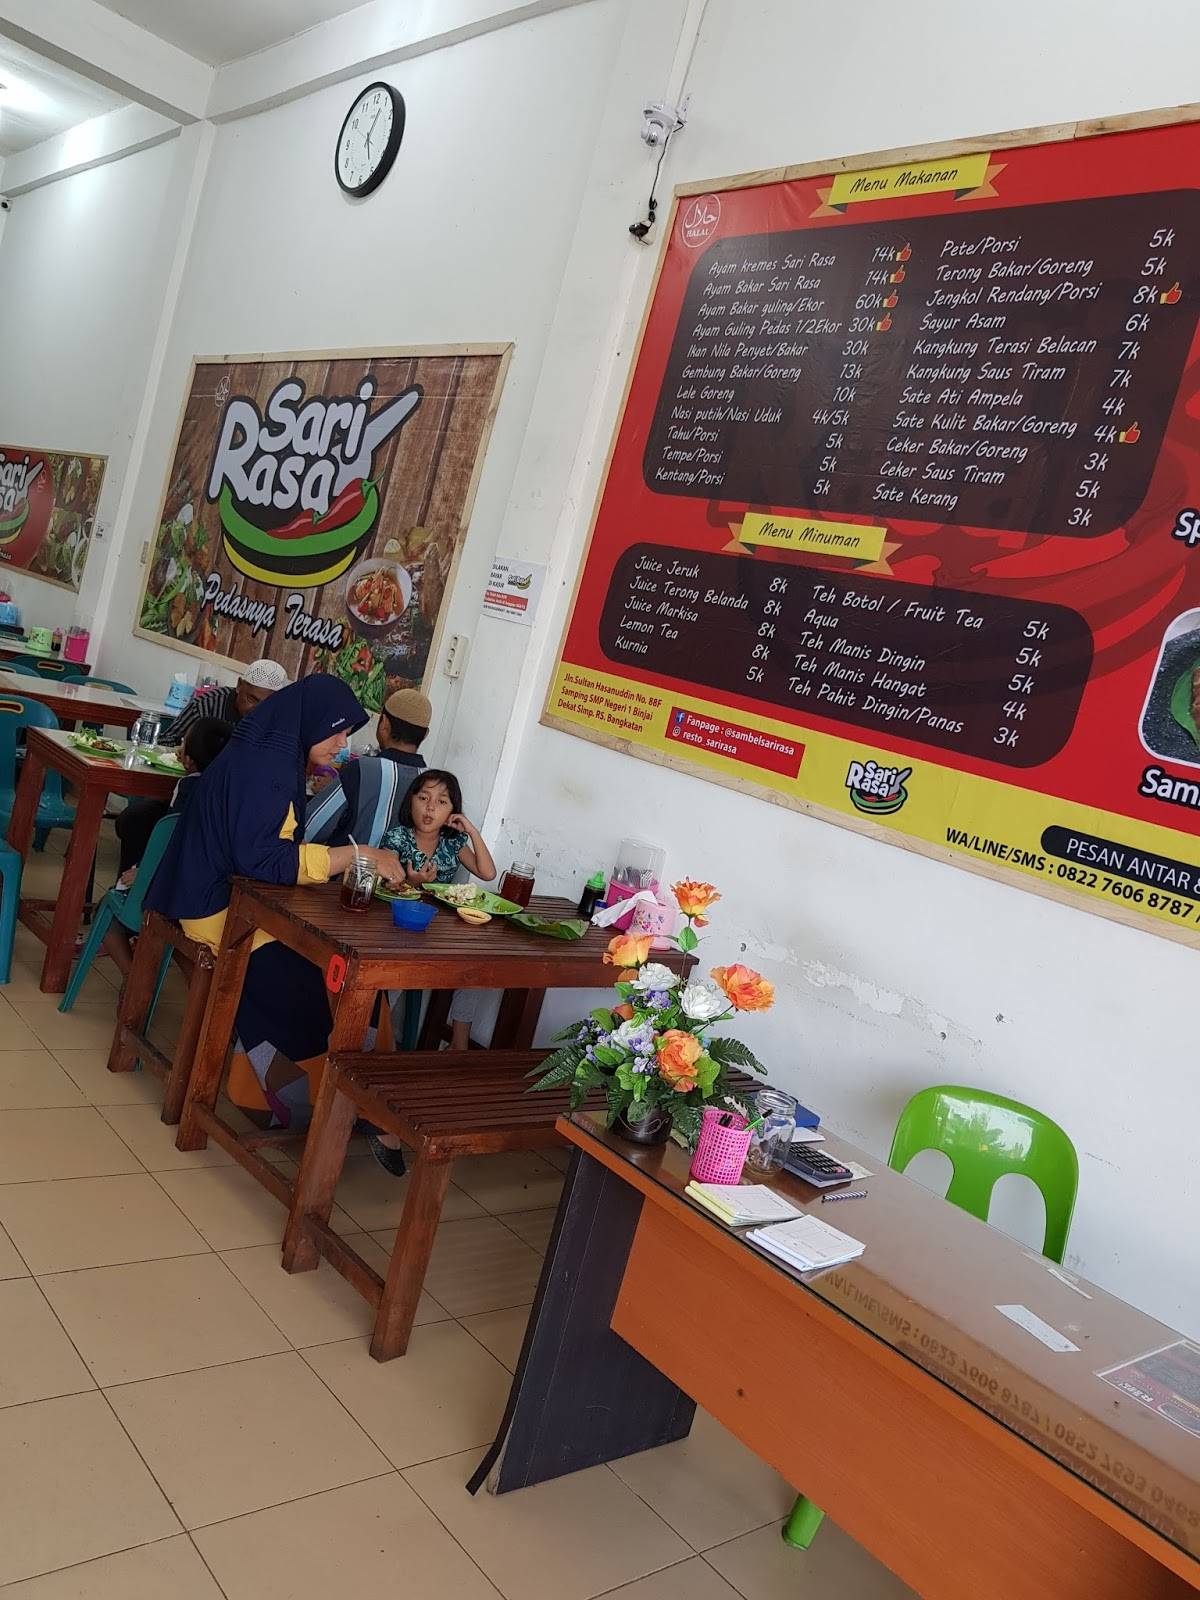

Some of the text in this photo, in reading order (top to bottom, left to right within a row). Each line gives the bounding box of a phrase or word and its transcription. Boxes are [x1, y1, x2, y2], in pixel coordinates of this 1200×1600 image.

[850, 169, 958, 194] Menu Makanan
[940, 228, 1176, 258] Pete/Porsi 5k
[709, 246, 895, 278] Ayam kremes Sari Rasa 14k
[936, 257, 1167, 284] Terong Bakar/Goreng 5k
[704, 270, 888, 300] Ayam Bakar Sari Rasa 14k
[926, 282, 1158, 308] Jengkol Rendang/Porsi 8k
[698, 294, 882, 320] Ayam Bakar guling/Ekor 60k
[692, 318, 875, 340] Ayam Guling Pedas 1/2Ekor 30k
[920, 313, 1152, 335] Sayur Asam 6k
[688, 341, 868, 360] Ikan Nila Penyet/Bakar 30k
[913, 336, 1140, 360] Kangkung Terasi Belacan 7k
[682, 364, 862, 382] Gembung Bakar/Goreng 13k
[906, 362, 1132, 388] Kangkung Saus Tiram 7k
[677, 386, 856, 402] Lele Goreng 10k
[899, 387, 1126, 416] Sate Ati Ampela 4k
[259, 382, 374, 458] Sari
[671, 406, 850, 426] Nasi putih/Nasi Uduk 4k/5k
[892, 412, 1117, 444] Sate Kulit Bakar/Goreng 4k
[668, 426, 844, 449] Tahu/Porsi 5k
[886, 436, 1109, 472] Ceker Bakar/Goreng 3k
[209, 401, 336, 516] Rasa
[662, 447, 838, 472] Tempe/Porsi 5k
[655, 468, 831, 495] Kentang/Porsi 5k
[880, 461, 1101, 499] Ceker Saus Tiram 5k
[872, 484, 1093, 527] Sate Kerang 3k
[758, 522, 861, 548] Menu Minuman
[635, 556, 788, 594] Juice Jeruk 8k
[201, 573, 342, 648] Pedasnya Terasa
[630, 576, 782, 616] Juice Terong Belanda 8k
[812, 585, 836, 604] Teh
[842, 592, 884, 611] Botol
[904, 602, 946, 622] Fruit
[955, 609, 984, 629] Tea
[1023, 620, 1050, 640] 5k
[624, 596, 776, 639] Juice Markisa 8k
[620, 614, 770, 661] Lemon Tea 8k
[804, 609, 1042, 668] Aqua 5k
[614, 635, 765, 682] Kurnia 5k
[800, 632, 1035, 694] Teh Manis Dingin 5k
[561, 686, 588, 703] Samping
[590, 694, 604, 704] SMP
[604, 698, 626, 712] Negeri
[632, 708, 653, 720] Binjai
[595, 681, 634, 700] Hasanuddin
[636, 694, 647, 704] No.
[794, 654, 1028, 721] Teh Manis Hangat 4k
[558, 698, 576, 712] Dekat
[596, 710, 606, 720] RS.
[607, 714, 643, 732] Bangkatan
[788, 677, 1020, 748] Teh Pahit Dingin/Panas 3k
[686, 715, 794, 755] Fanpage @sambelsarirasa
[846, 762, 889, 797] Rasa
[864, 762, 897, 785] Sari
[1142, 769, 1200, 806] Sam
[946, 827, 1194, 918] WA/LINE/SMS 0822 7606 8787
[1066, 838, 1124, 869] PESAN
[1126, 858, 1190, 890] ANTAR
